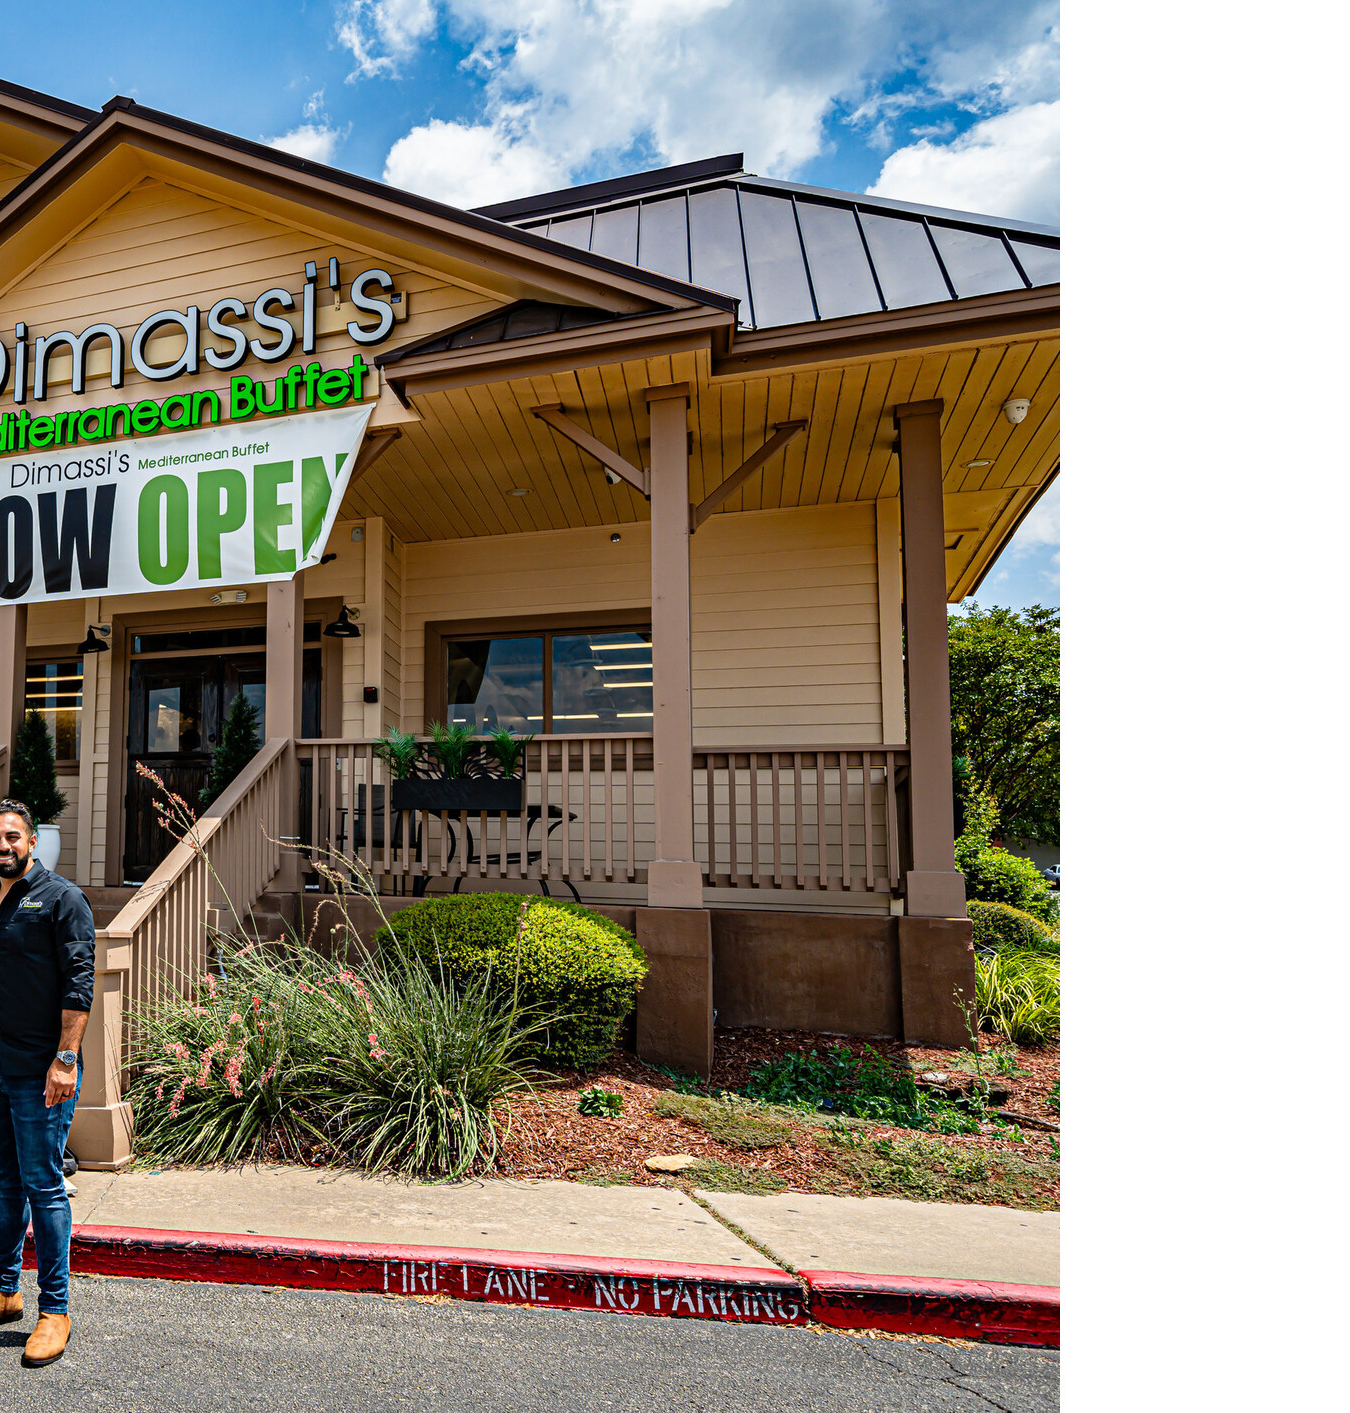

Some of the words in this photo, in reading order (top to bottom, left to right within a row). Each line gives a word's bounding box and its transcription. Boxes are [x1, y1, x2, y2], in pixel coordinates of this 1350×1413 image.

[230, 354, 371, 419] Buffet
[10, 450, 130, 488] Dimassi's
[138, 450, 229, 470] Mediterranean
[232, 441, 269, 458] Buffet
[384, 1260, 449, 1293] FIRE
[461, 1264, 550, 1301] LANE
[594, 1273, 640, 1309] NO
[653, 1273, 800, 1320] PARKING
